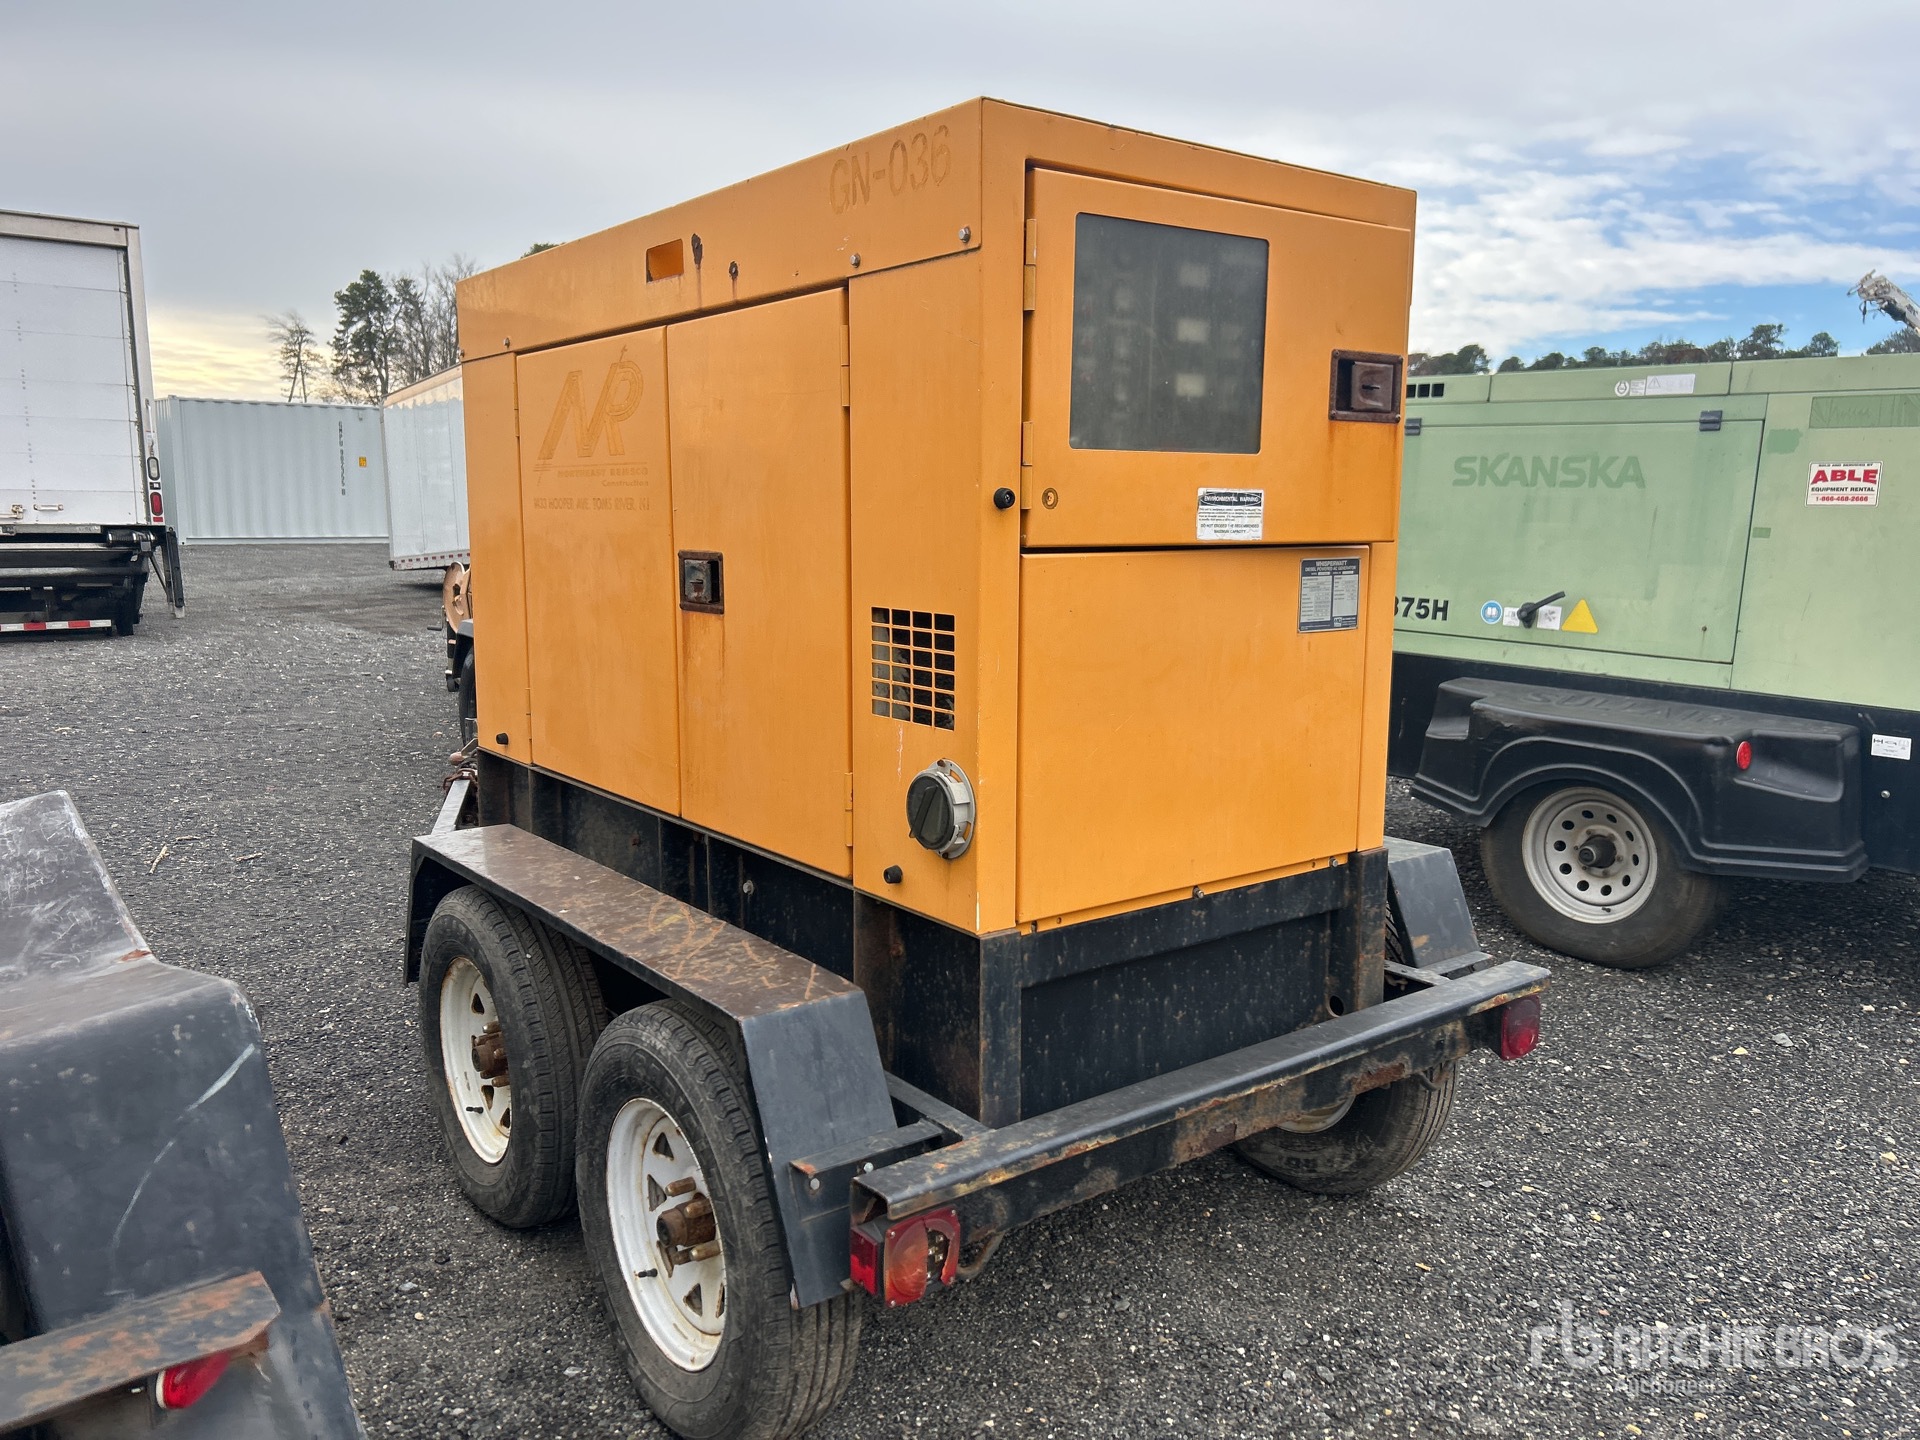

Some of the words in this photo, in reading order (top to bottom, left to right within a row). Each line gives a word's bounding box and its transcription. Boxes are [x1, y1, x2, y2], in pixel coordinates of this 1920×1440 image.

[829, 124, 950, 215] GN-036
[1452, 453, 1646, 489] SKANSKA
[1810, 469, 1878, 485] ABLE
